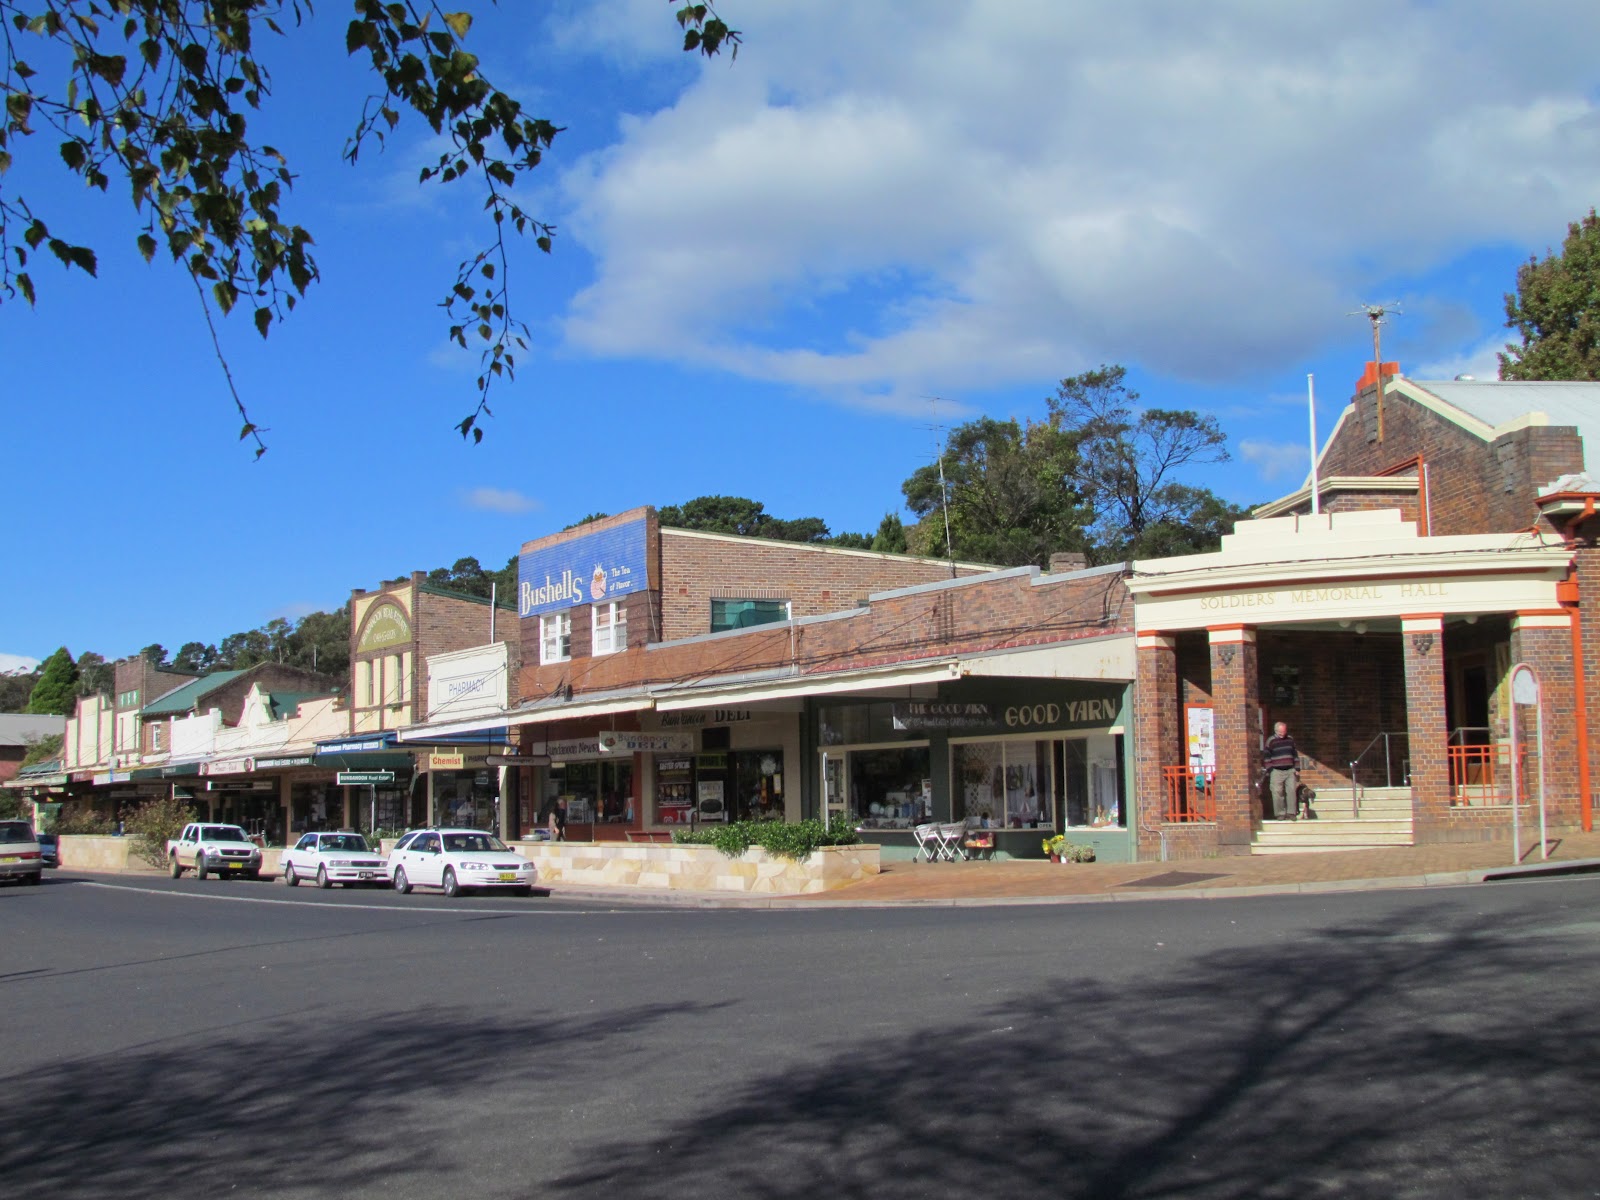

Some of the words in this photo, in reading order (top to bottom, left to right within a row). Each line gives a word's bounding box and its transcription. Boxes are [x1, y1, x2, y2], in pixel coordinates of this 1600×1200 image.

[611, 568, 620, 577] The
[621, 566, 631, 575] Tea
[521, 570, 583, 615] Bushells
[1200, 592, 1275, 610] SOLDIERS
[1291, 585, 1383, 604] MEMORIAL
[1400, 583, 1449, 598] HALL
[448, 678, 486, 697] PHARMACY
[930, 703, 960, 715] GOOD
[1005, 703, 1061, 727] GOOD
[1066, 698, 1116, 722] YARN
[714, 709, 752, 722] DELI
[617, 734, 674, 745] Bundanoon
[626, 742, 669, 751] DELI
[433, 757, 461, 765] Chemist
